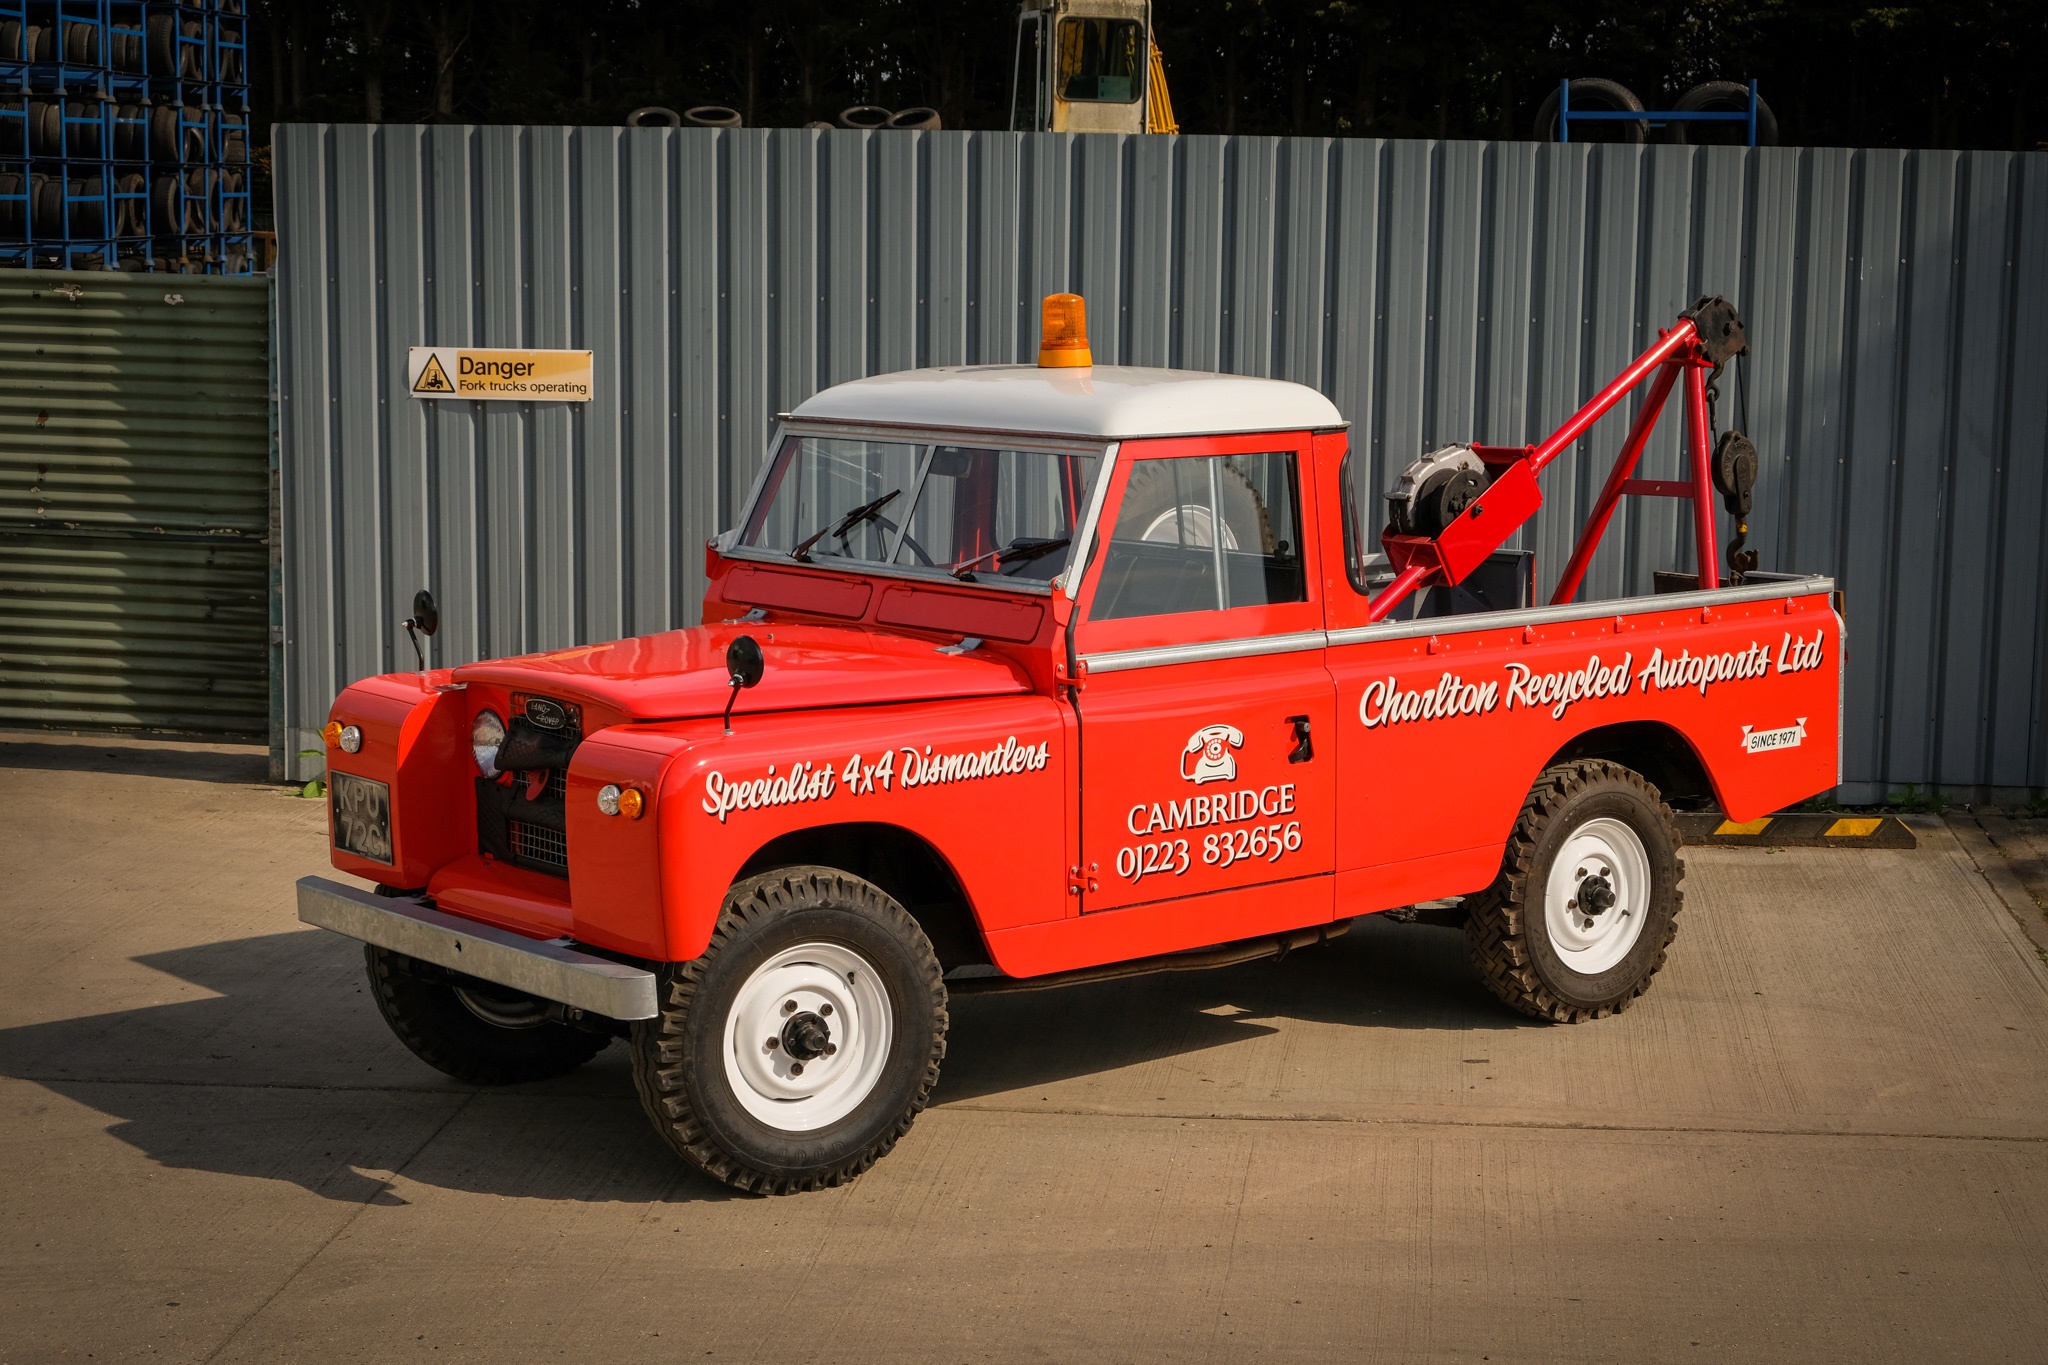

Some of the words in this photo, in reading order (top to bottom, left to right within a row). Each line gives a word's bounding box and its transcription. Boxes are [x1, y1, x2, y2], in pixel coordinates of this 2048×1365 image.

[459, 356, 535, 380] Danger
[459, 379, 486, 391] Fork
[489, 380, 527, 393] trucks
[529, 382, 587, 395] operating
[1359, 671, 1499, 727] Charlton
[1504, 652, 1632, 719] Recycled
[1637, 640, 1772, 694] Autoparts
[1776, 628, 1823, 673] Ltd
[1751, 733, 1777, 749] SINCE
[1779, 731, 1796, 744] 1971
[340, 778, 381, 818] KPU
[702, 760, 835, 822] Specialist
[841, 749, 894, 795] 4x4
[899, 735, 1051, 788] Dismantlers
[1127, 783, 1296, 836] CAMBRIDGE
[341, 815, 382, 856] 72C
[1116, 838, 1190, 884] 01223
[1202, 821, 1302, 868] 832656
